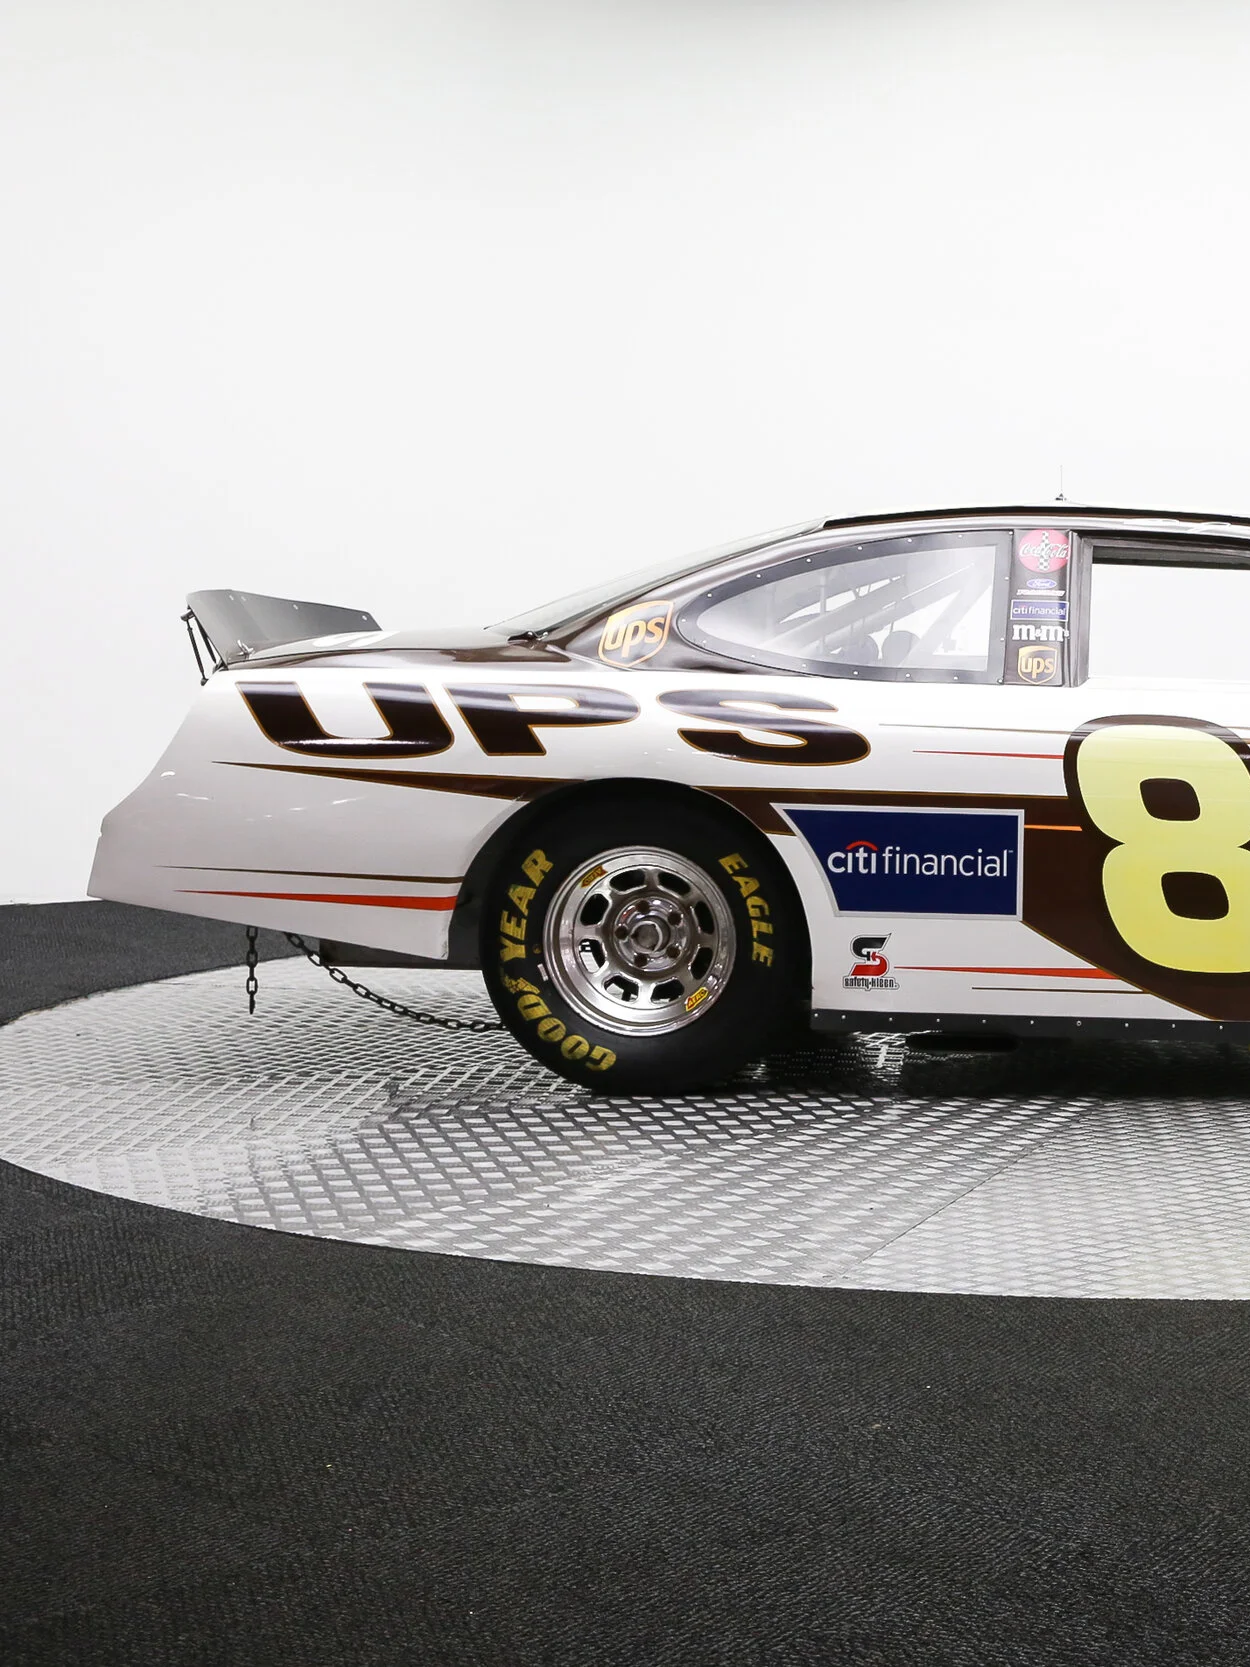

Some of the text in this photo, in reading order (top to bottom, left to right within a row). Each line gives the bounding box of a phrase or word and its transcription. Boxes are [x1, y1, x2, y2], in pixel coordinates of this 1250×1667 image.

[604, 617, 665, 657] ups
[1020, 656, 1054, 679] ups
[235, 681, 871, 767] UPS
[718, 853, 774, 968] EAGLE
